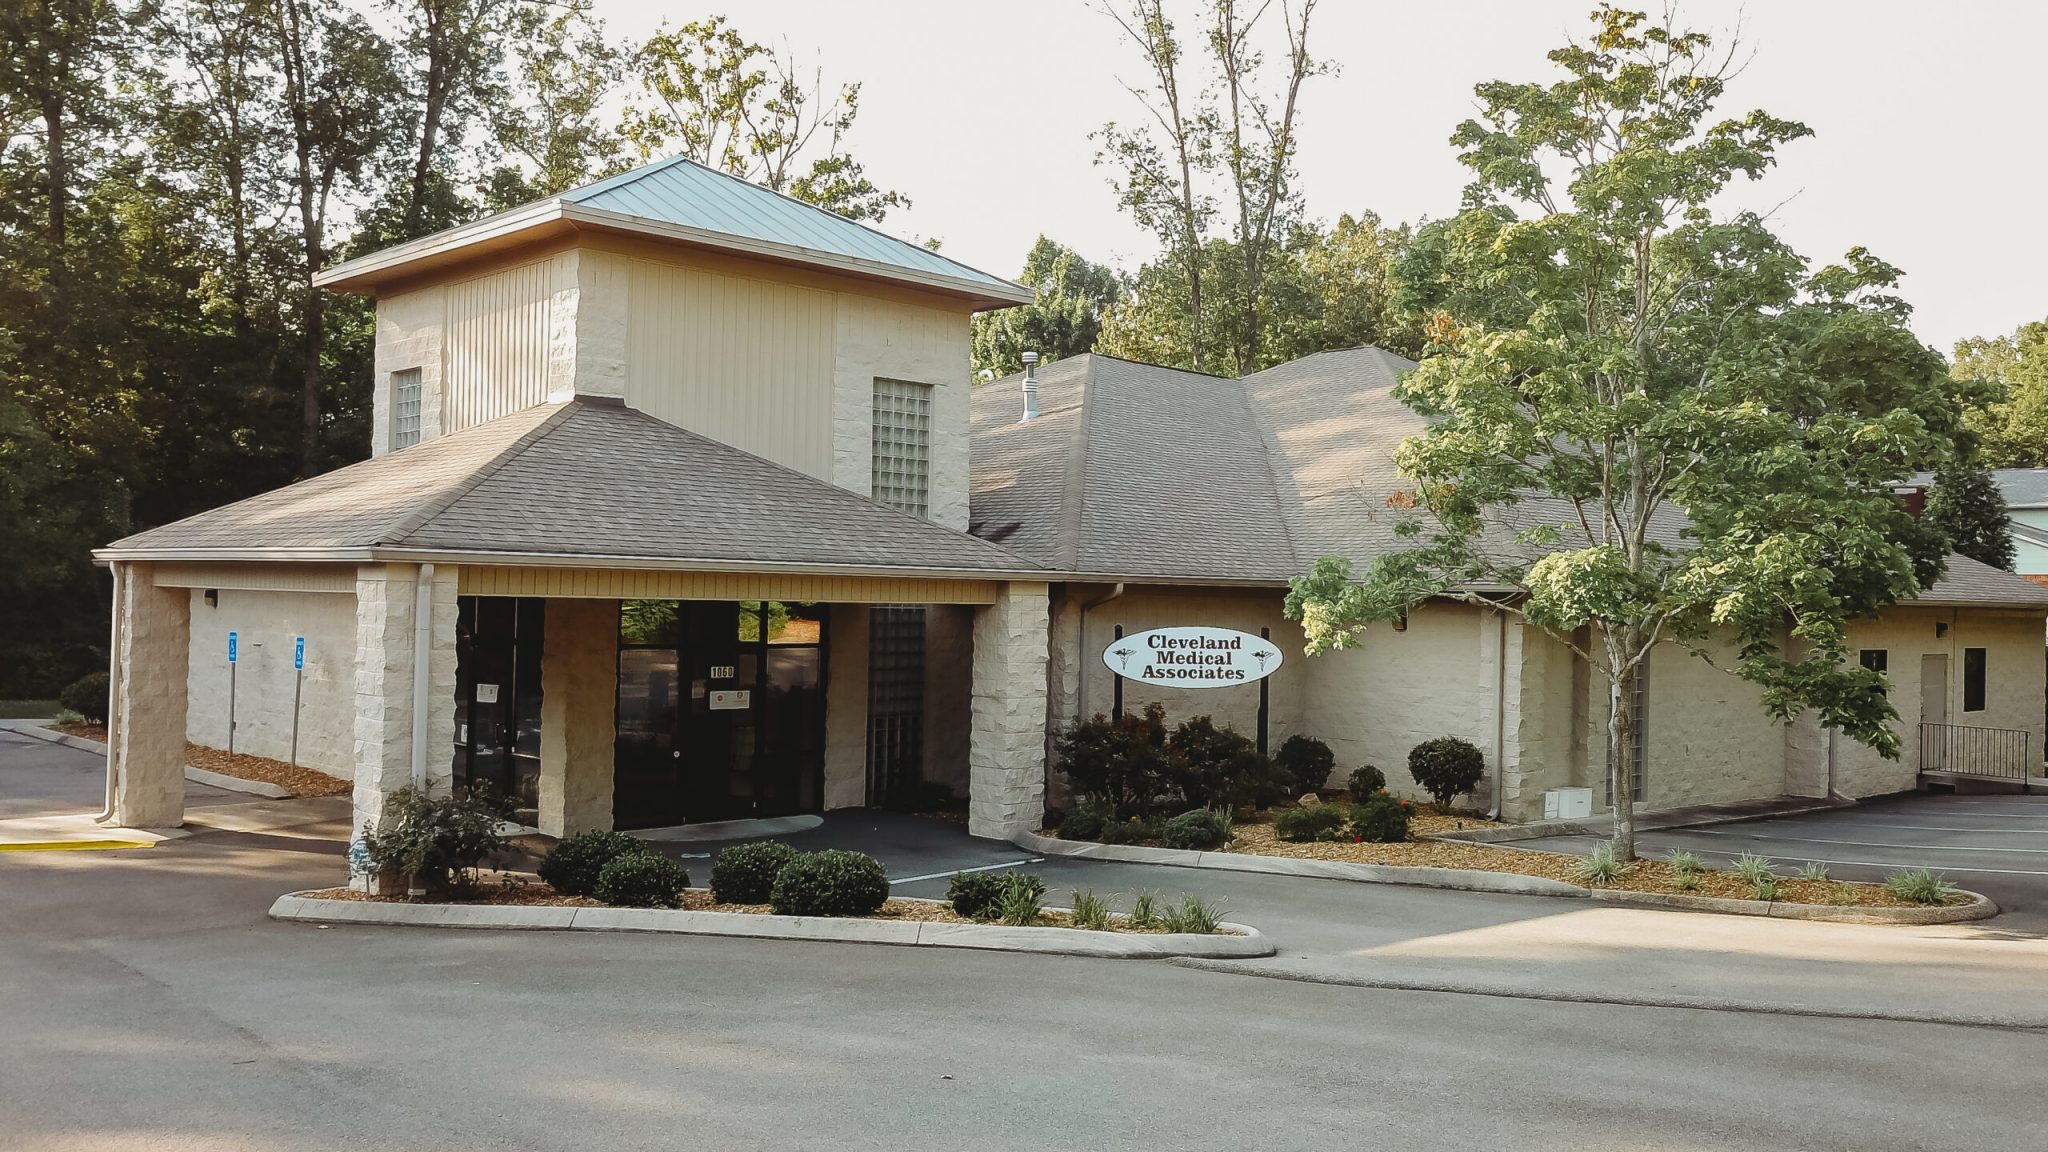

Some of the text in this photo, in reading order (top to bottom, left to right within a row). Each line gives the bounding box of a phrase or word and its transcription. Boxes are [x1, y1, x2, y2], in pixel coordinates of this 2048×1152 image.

[1147, 634, 1242, 650] Cleveland
[1156, 651, 1233, 665] Medical
[712, 667, 733, 678] 1060
[1141, 665, 1245, 680] Associates
